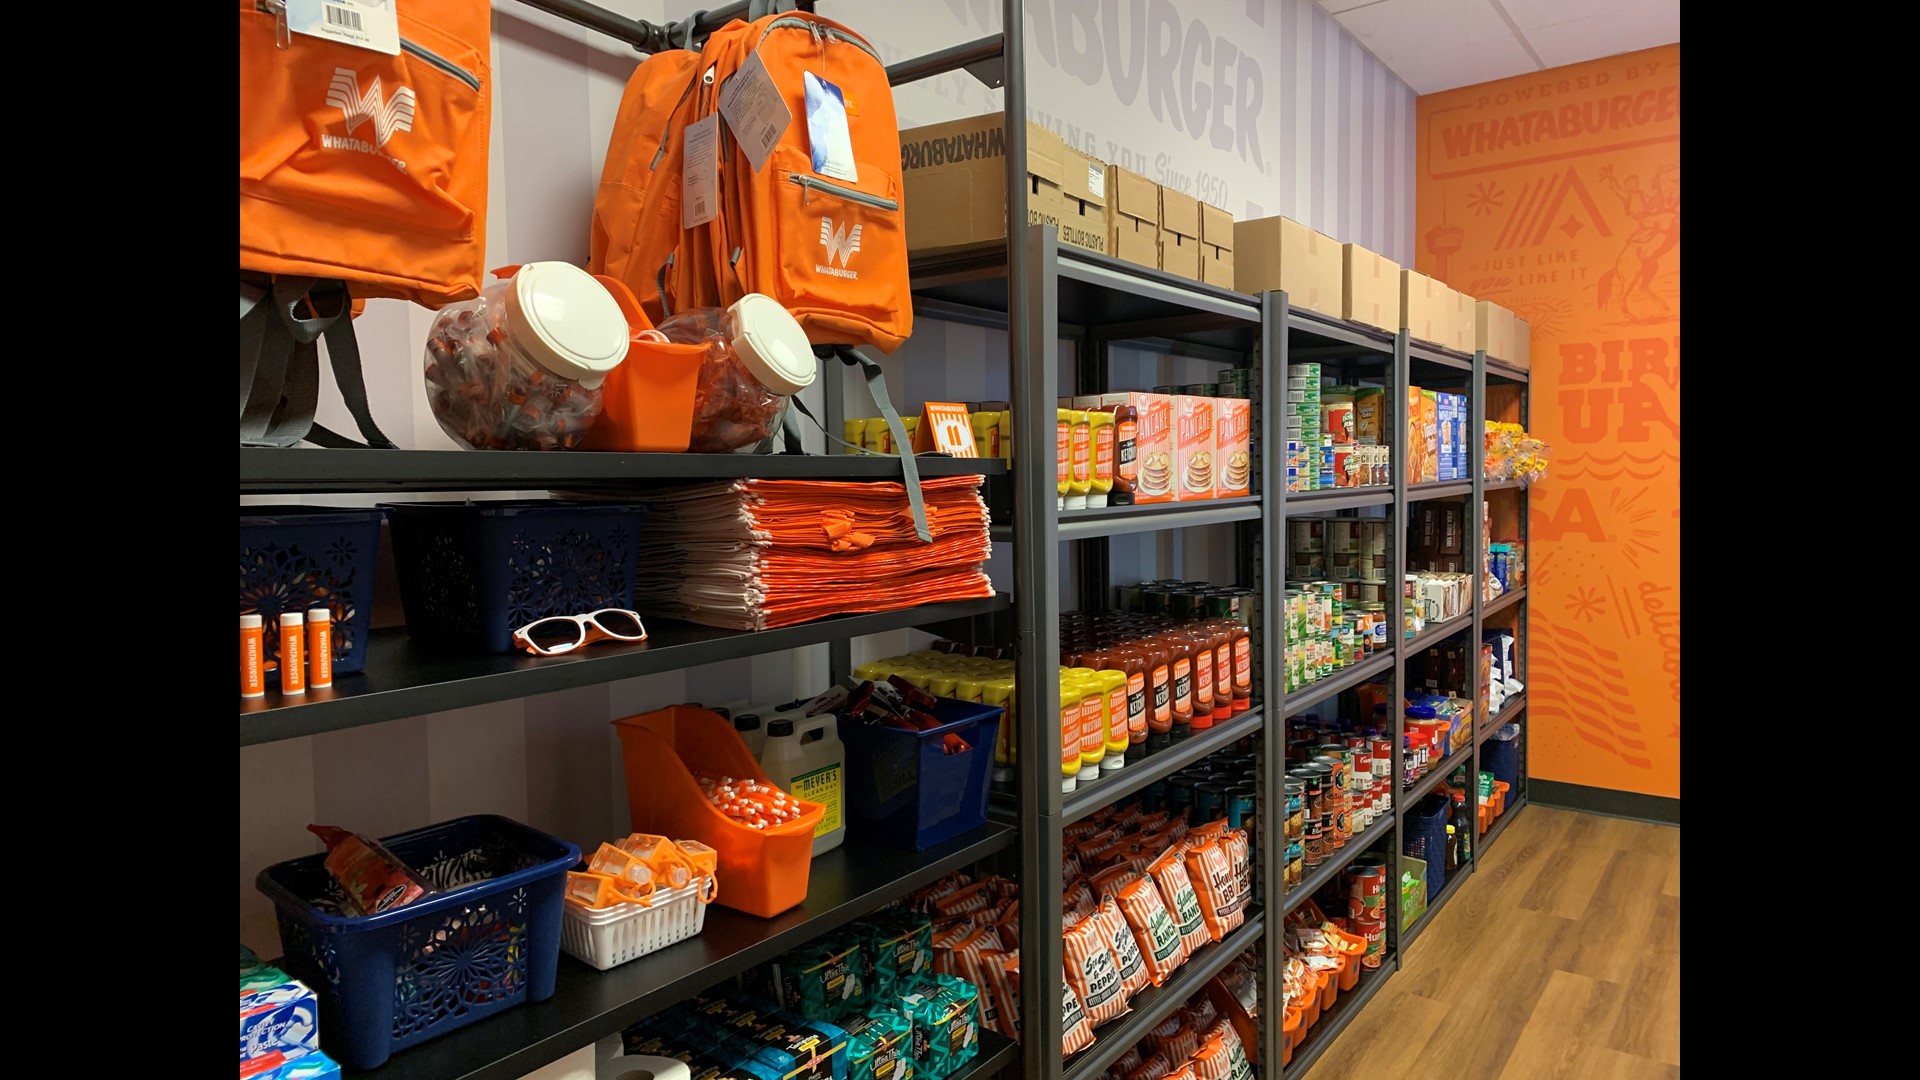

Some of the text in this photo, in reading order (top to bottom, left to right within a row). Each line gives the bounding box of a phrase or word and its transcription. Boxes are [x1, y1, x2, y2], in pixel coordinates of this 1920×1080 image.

[1476, 61, 1662, 111] POWERED BY
[1441, 84, 1680, 160] WHATABURGE
[900, 127, 1006, 172] WHATABURG
[1154, 151, 1192, 194] Since
[1194, 168, 1229, 210] 1950
[815, 263, 859, 280] WHATABURGER
[1483, 249, 1580, 272] JUST LIKE
[1518, 269, 1560, 287] LIKE
[1570, 266, 1588, 281] IT
[1558, 335, 1680, 386] BIR
[1181, 409, 1212, 445] PANCAKE
[1220, 411, 1249, 446] PANCAKE
[247, 637, 258, 688] WHATABURGER
[288, 635, 299, 685] WHATABURGER
[319, 630, 329, 679] WHATABURGER
[803, 783, 837, 799] CLEAN DAY
[804, 770, 837, 791] MEYER'S
[1182, 903, 1200, 923] RANC
[240, 1022, 287, 1042] ROTECTION
[246, 1018, 275, 1034] CAVITY
[785, 1034, 820, 1051] Tampons
[870, 1054, 889, 1072] Ultra
